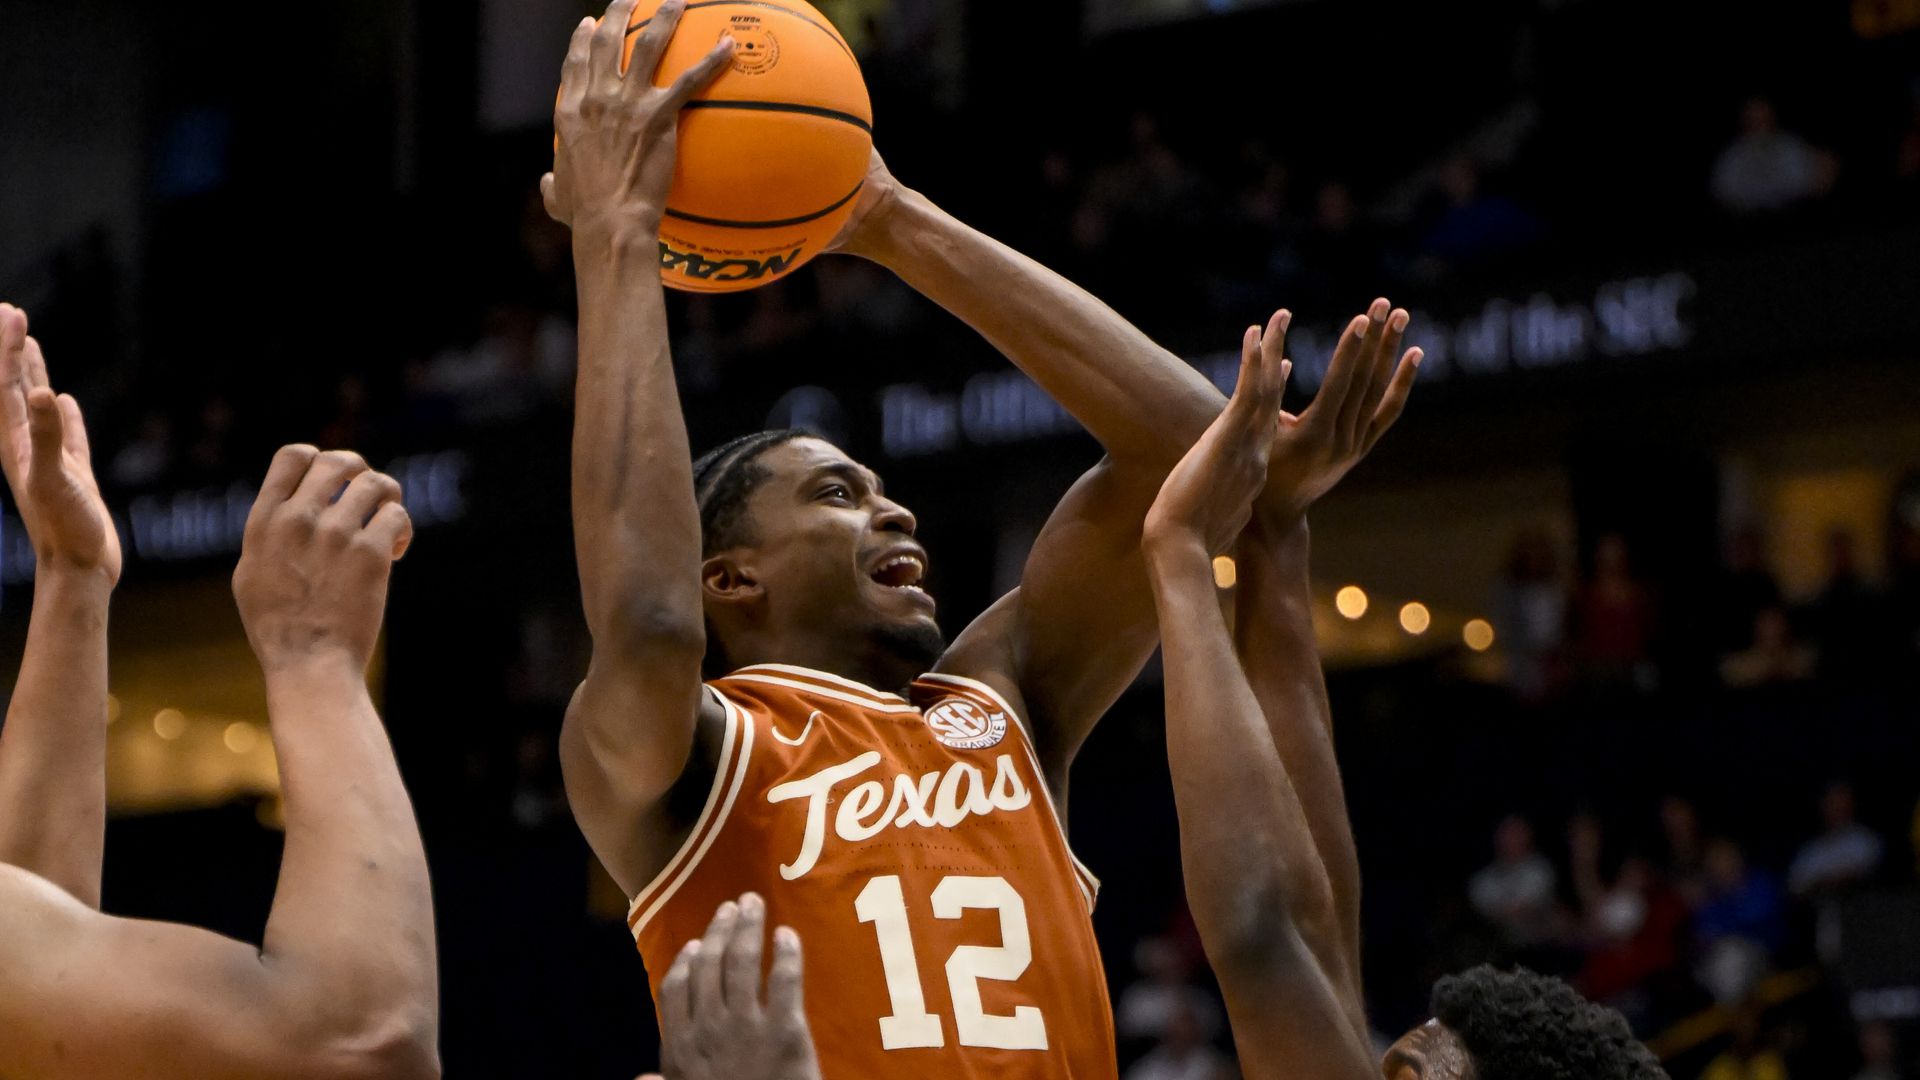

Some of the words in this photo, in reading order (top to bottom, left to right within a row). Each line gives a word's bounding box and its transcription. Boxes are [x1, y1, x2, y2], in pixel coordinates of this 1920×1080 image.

[1510, 291, 1590, 366] the
[1596, 272, 1696, 353] SEC
[929, 702, 985, 738] SEC
[948, 725, 1005, 750] GRADUATE
[767, 751, 1032, 881] Texas
[854, 875, 1048, 1050] 12
